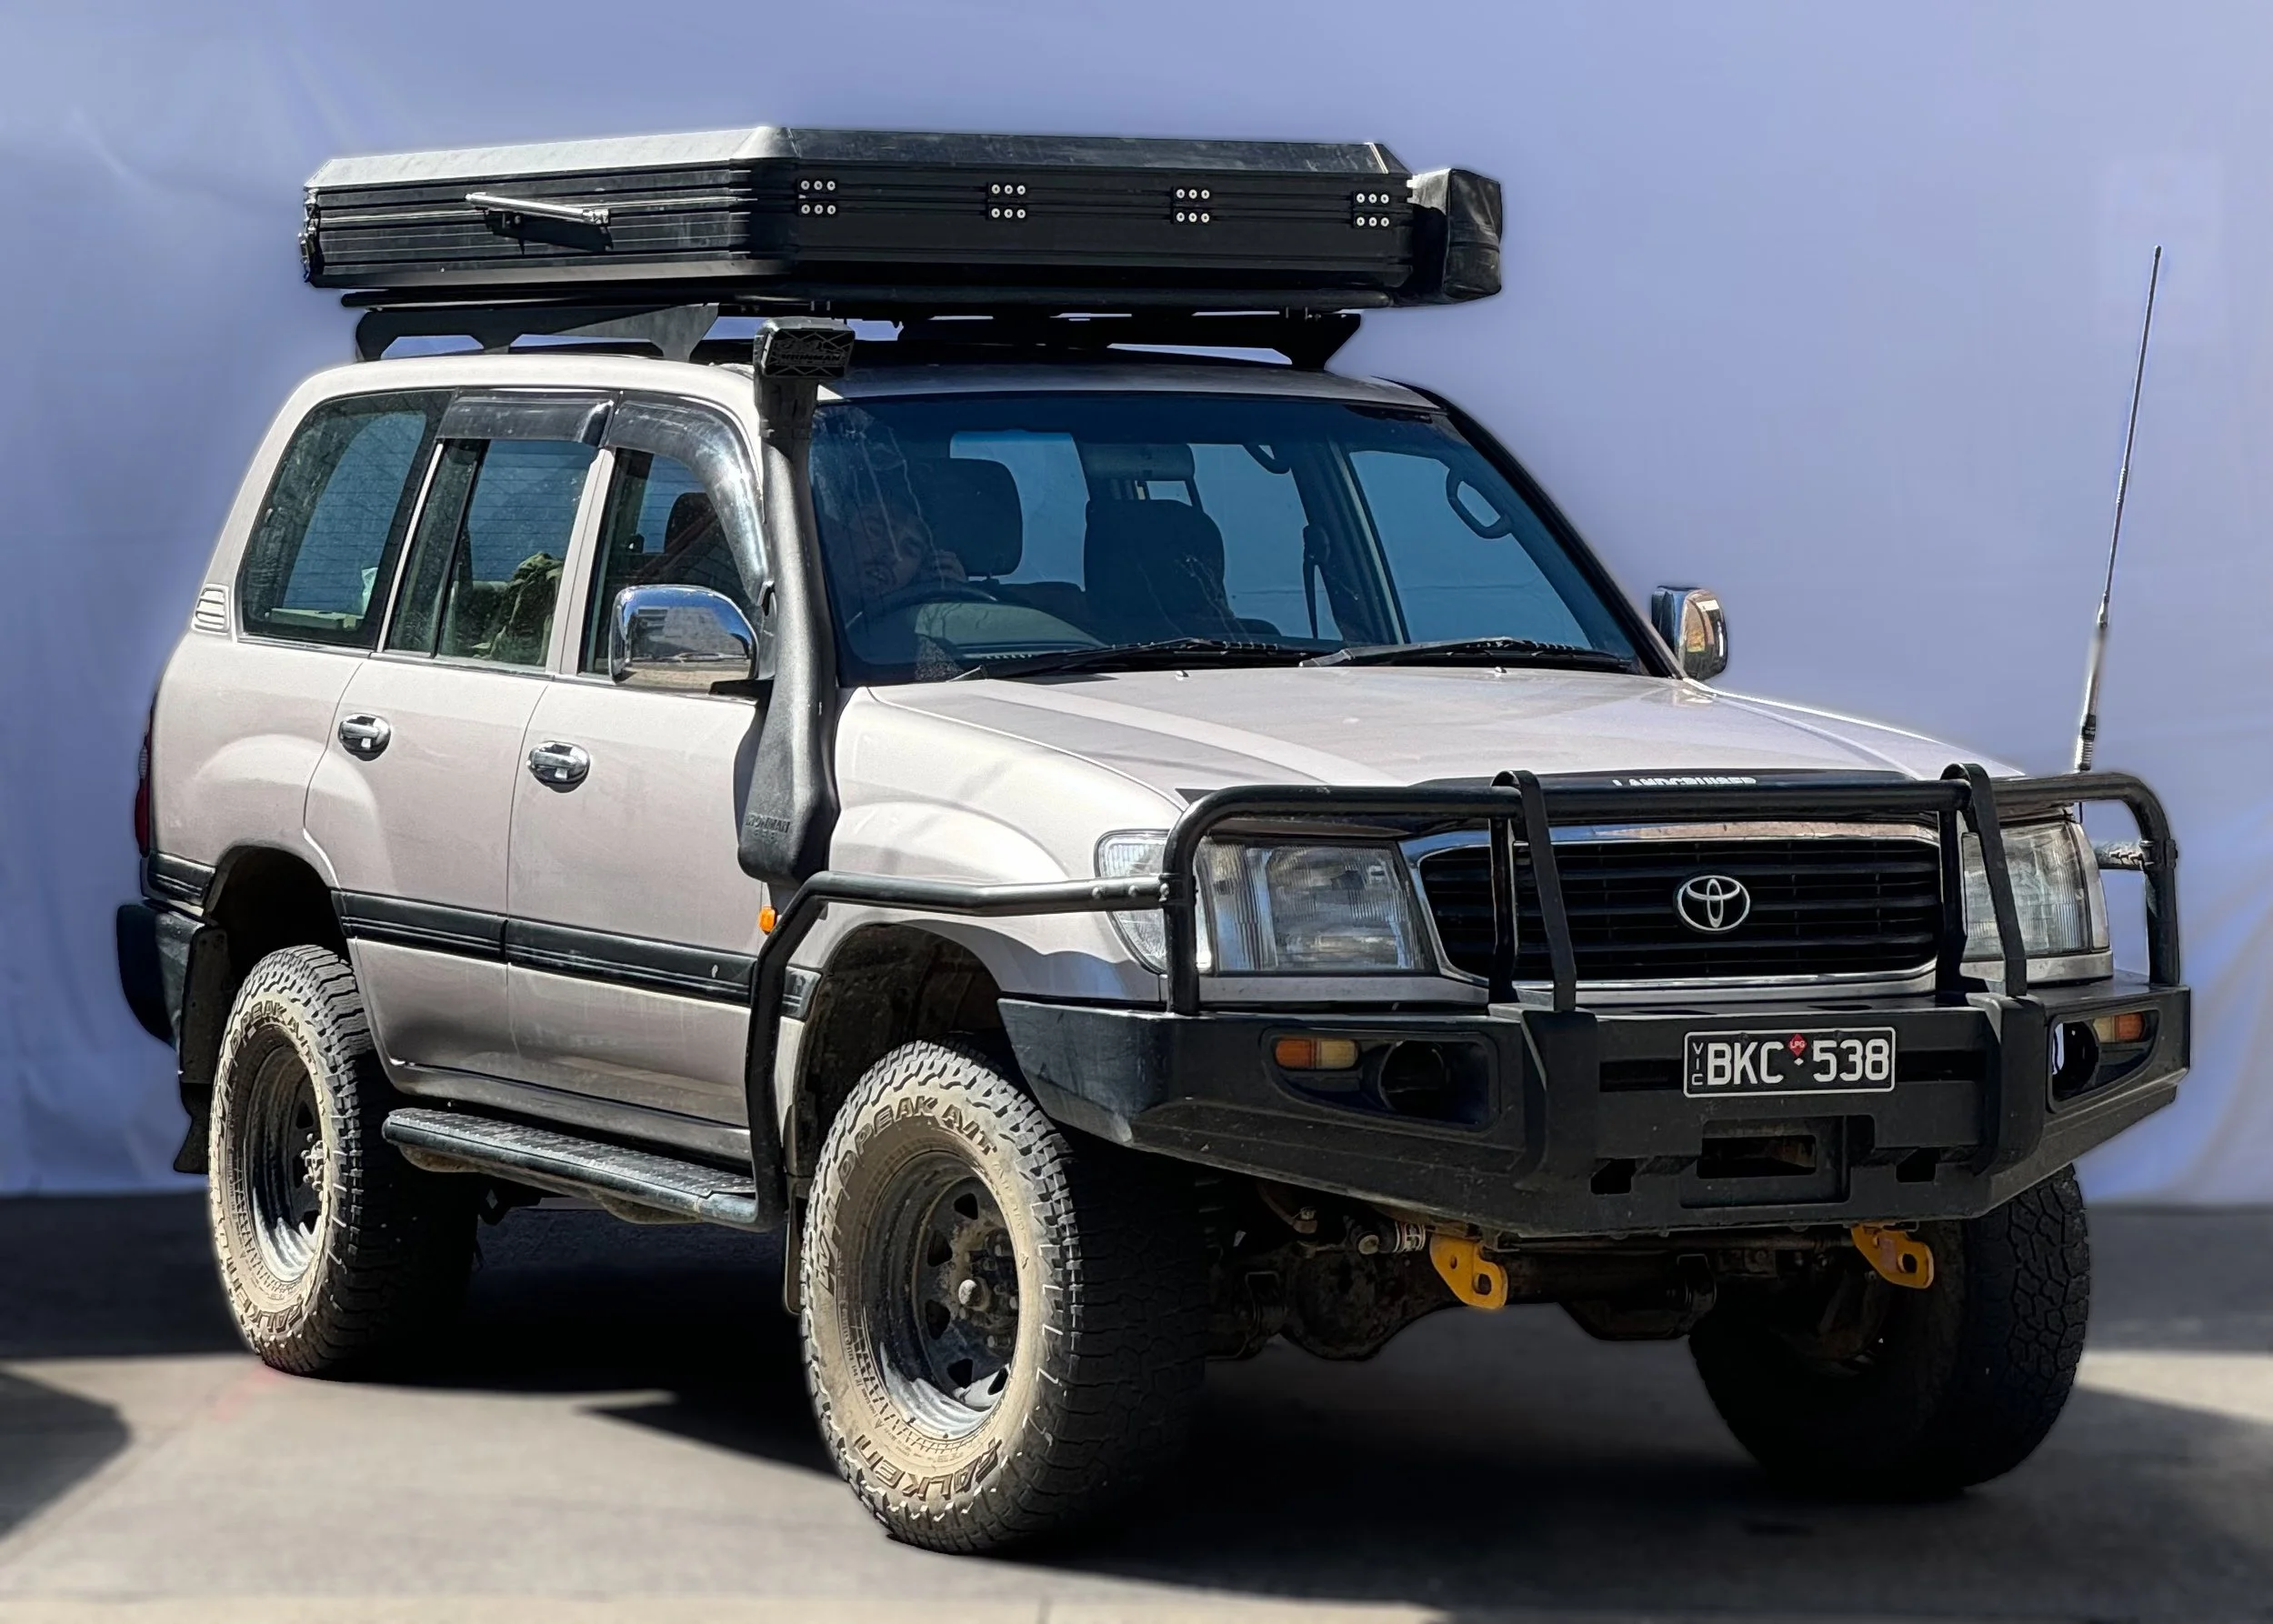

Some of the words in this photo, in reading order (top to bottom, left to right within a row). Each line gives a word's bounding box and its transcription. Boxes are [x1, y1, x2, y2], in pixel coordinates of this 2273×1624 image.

[1691, 1042, 1704, 1086] VIC
[1707, 1041, 1784, 1086] BKC
[1813, 1038, 1889, 1082] 538
[1789, 1039, 1806, 1049] LPG
[854, 1433, 1003, 1501] FALKEN
